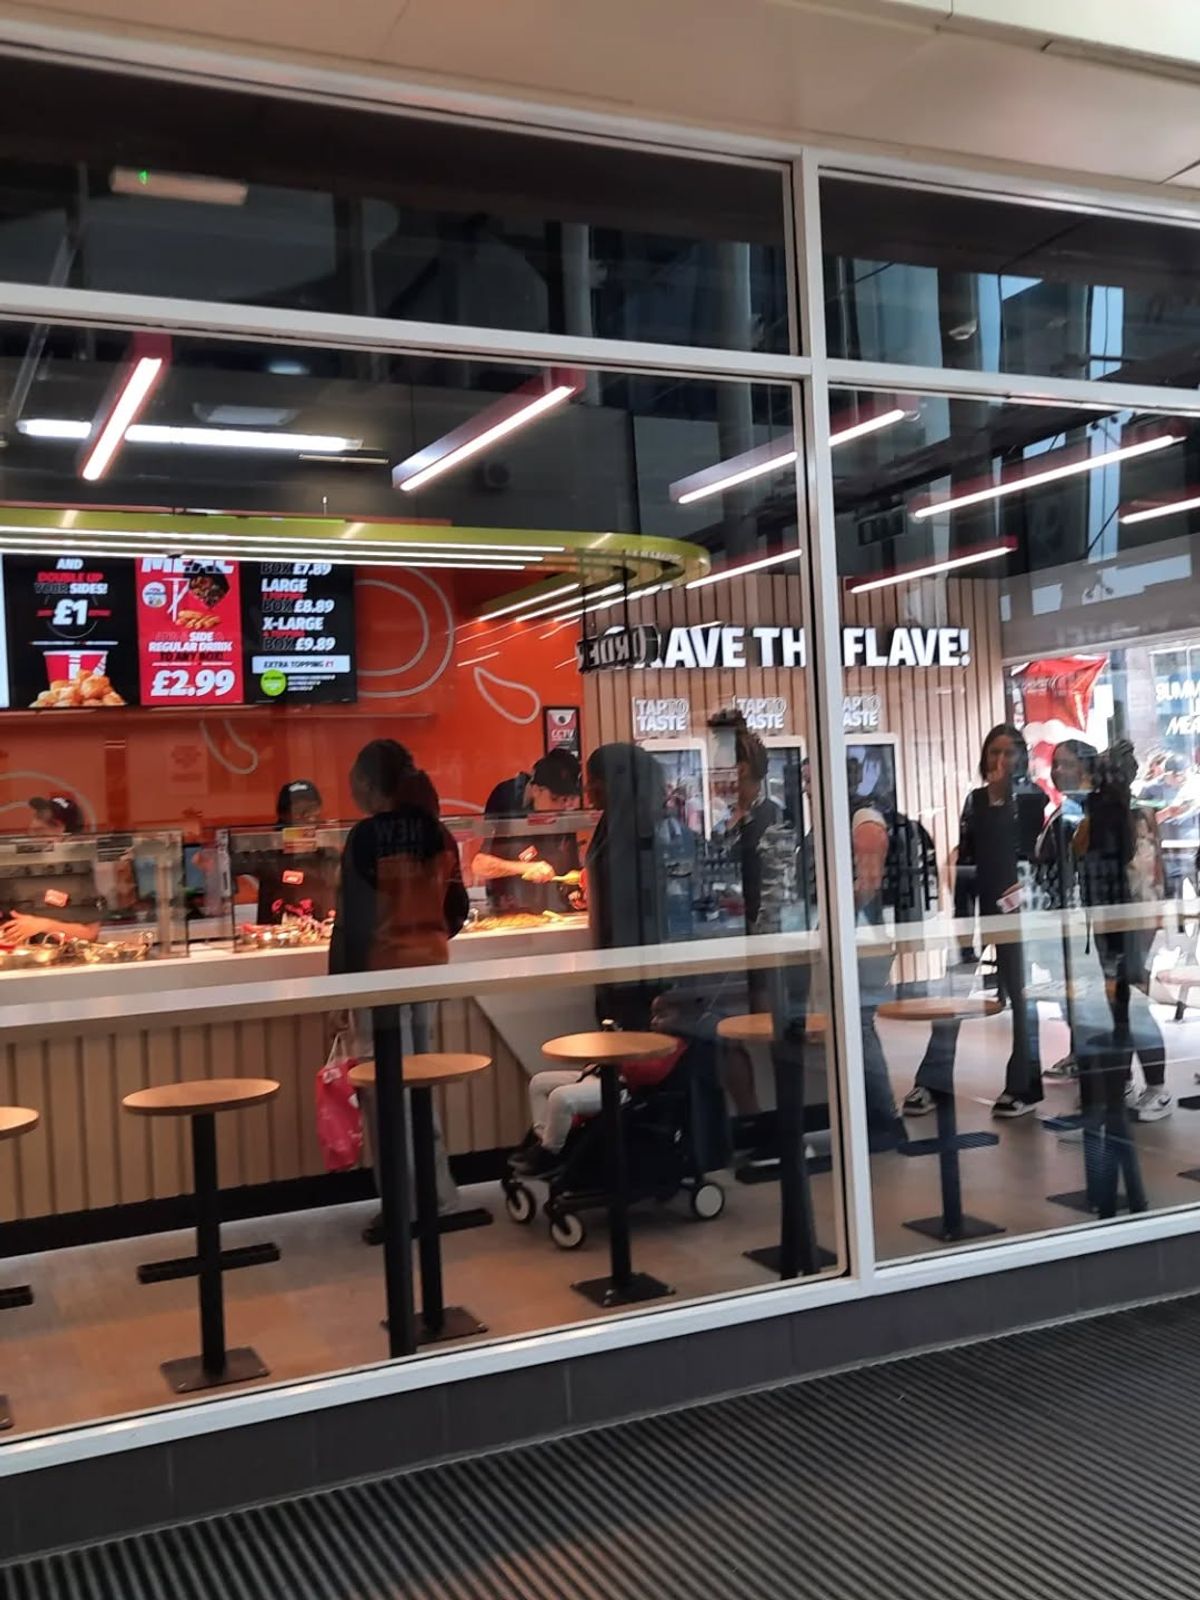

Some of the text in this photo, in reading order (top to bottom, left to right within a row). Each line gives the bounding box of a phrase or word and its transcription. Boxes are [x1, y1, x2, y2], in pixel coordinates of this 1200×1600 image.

[56, 558, 83, 570] AND
[261, 578, 308, 593] LARGE
[52, 598, 88, 626] £1
[293, 599, 336, 614] £8.89
[262, 616, 325, 631] X-LARGE
[294, 636, 337, 652] £9.89
[752, 626, 807, 669] TH
[843, 627, 970, 667] FLAVE!
[150, 669, 236, 697] £2.99
[635, 699, 668, 715] TAP
[842, 695, 863, 711] AP
[636, 714, 688, 732] TASTE
[742, 713, 785, 730] ASTE
[842, 711, 880, 727] ASTE
